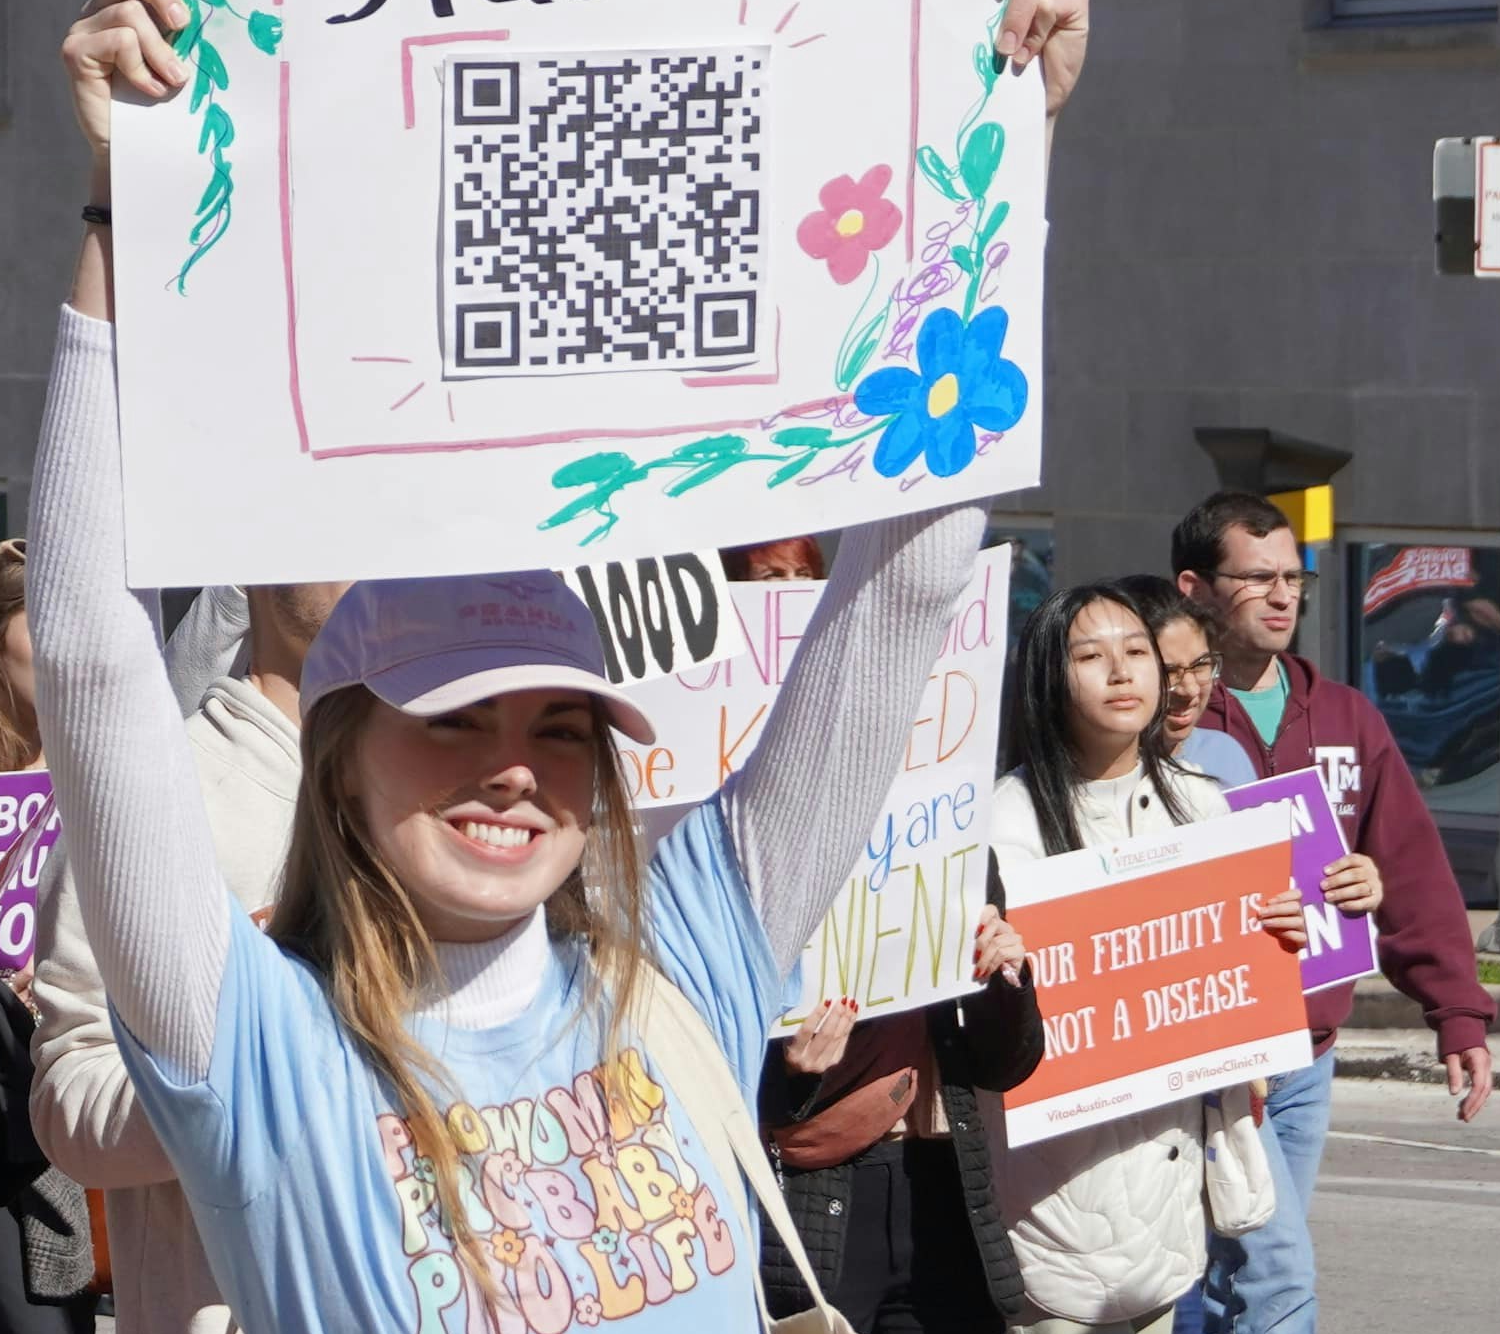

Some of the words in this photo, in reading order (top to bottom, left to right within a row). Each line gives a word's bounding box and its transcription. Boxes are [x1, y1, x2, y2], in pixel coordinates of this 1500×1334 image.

[906, 782, 975, 849] are
[1090, 901, 1226, 975] FERTILITY
[1239, 892, 1263, 936] IS
[1044, 1006, 1097, 1061] NOT
[1112, 998, 1132, 1042] A
[1142, 964, 1258, 1032] DISEASE.
[1047, 1090, 1133, 1123] VitaeAustin.com
[1187, 1051, 1270, 1083] @VitaeClinicTX
[525, 1122, 699, 1239] BABY
[579, 1185, 735, 1320] LIFE
